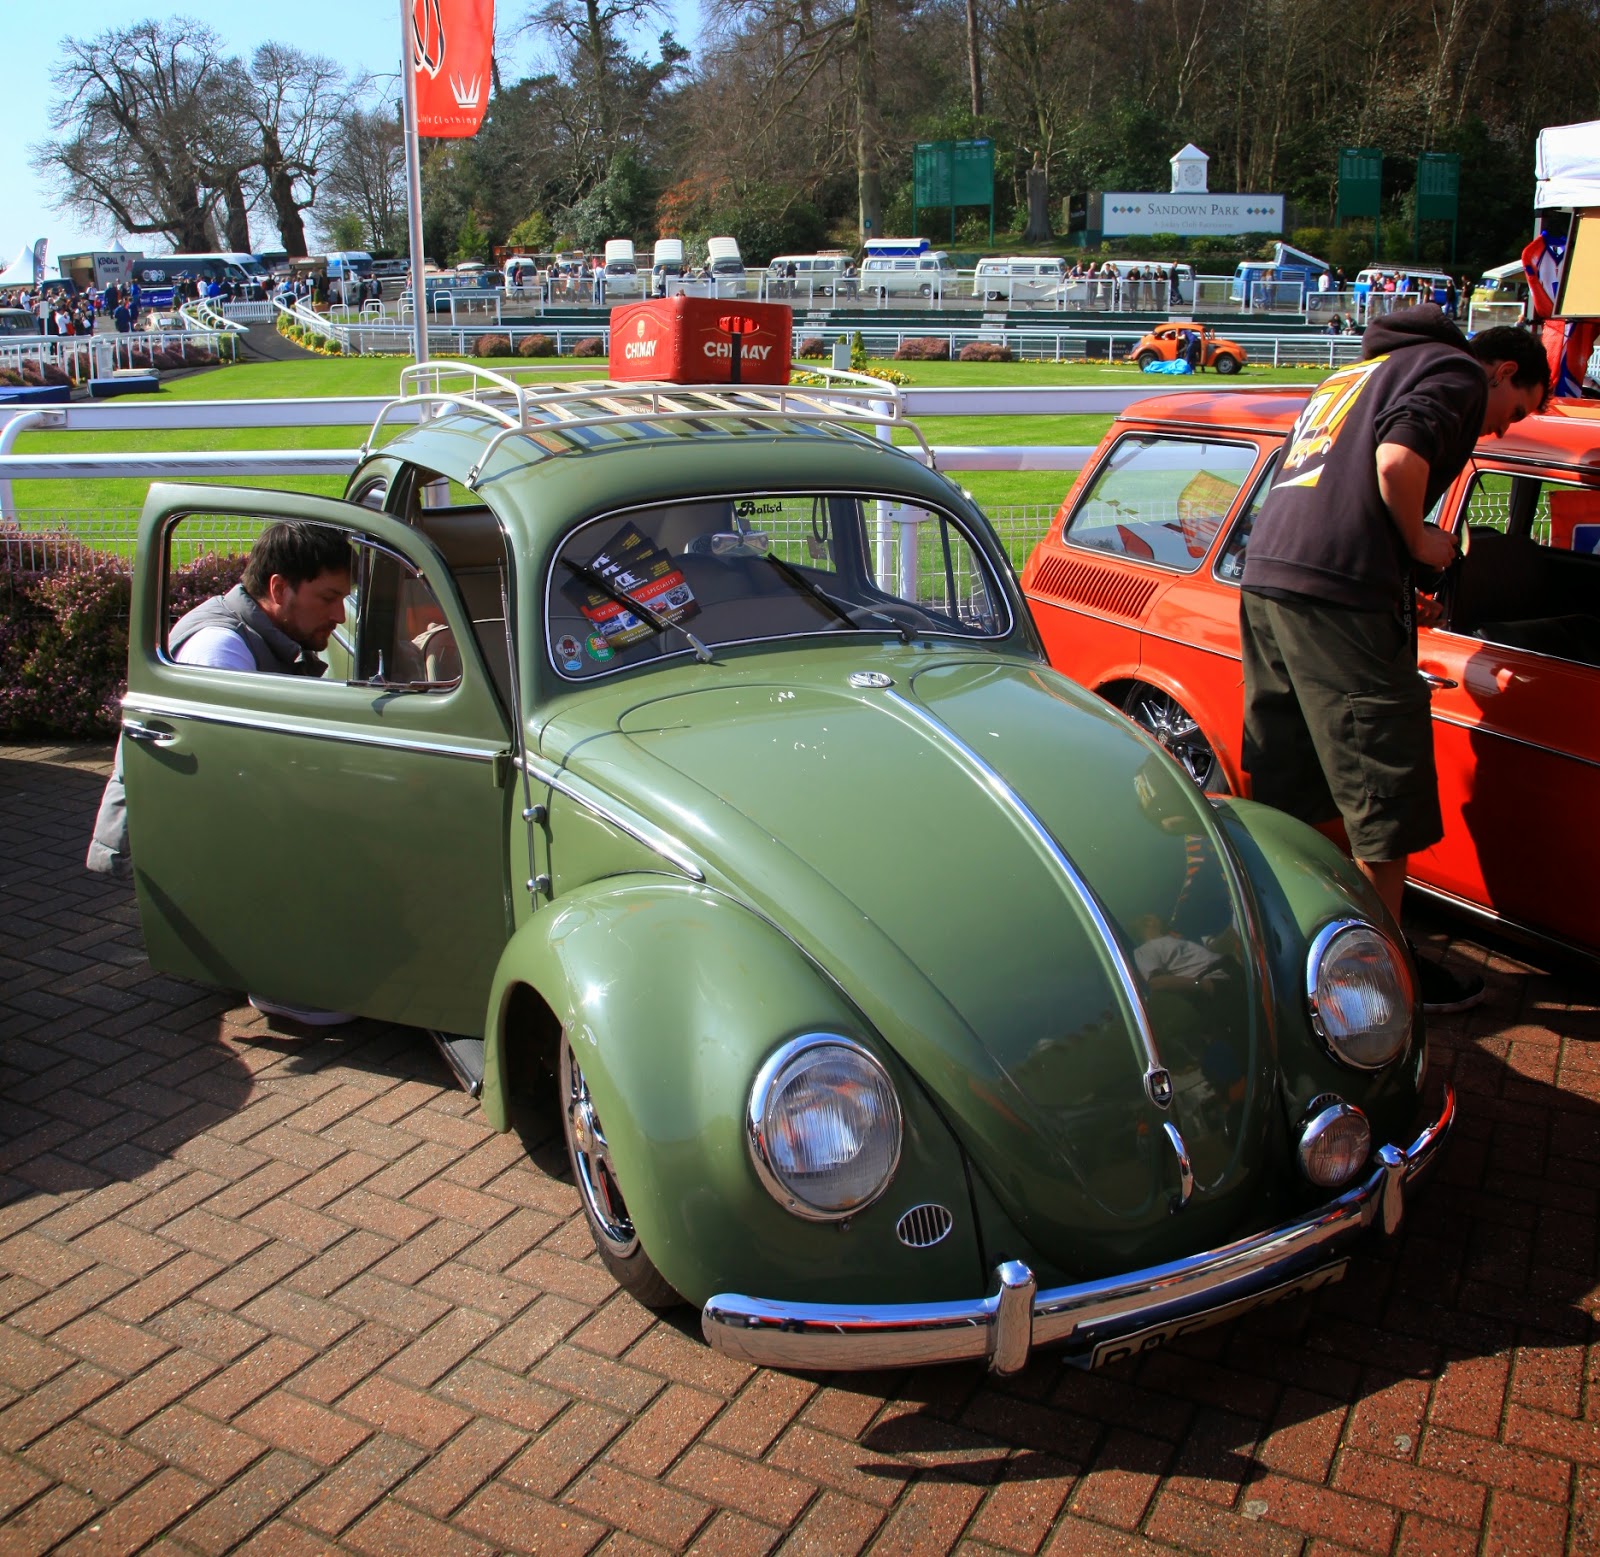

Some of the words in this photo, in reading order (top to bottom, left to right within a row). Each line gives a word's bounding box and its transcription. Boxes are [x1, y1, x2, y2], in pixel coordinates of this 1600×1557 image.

[434, 115, 477, 126] Clothing
[1148, 203, 1207, 216] SANDOWN
[1211, 204, 1240, 216] PARK
[1182, 219, 1198, 229] Club
[97, 257, 119, 268] KENDALL
[625, 339, 658, 360] CHIMAY
[737, 501, 782, 517] Balls'd
[647, 577, 676, 596] SPECIALIST
[1403, 575, 1411, 611] DIGITAL
